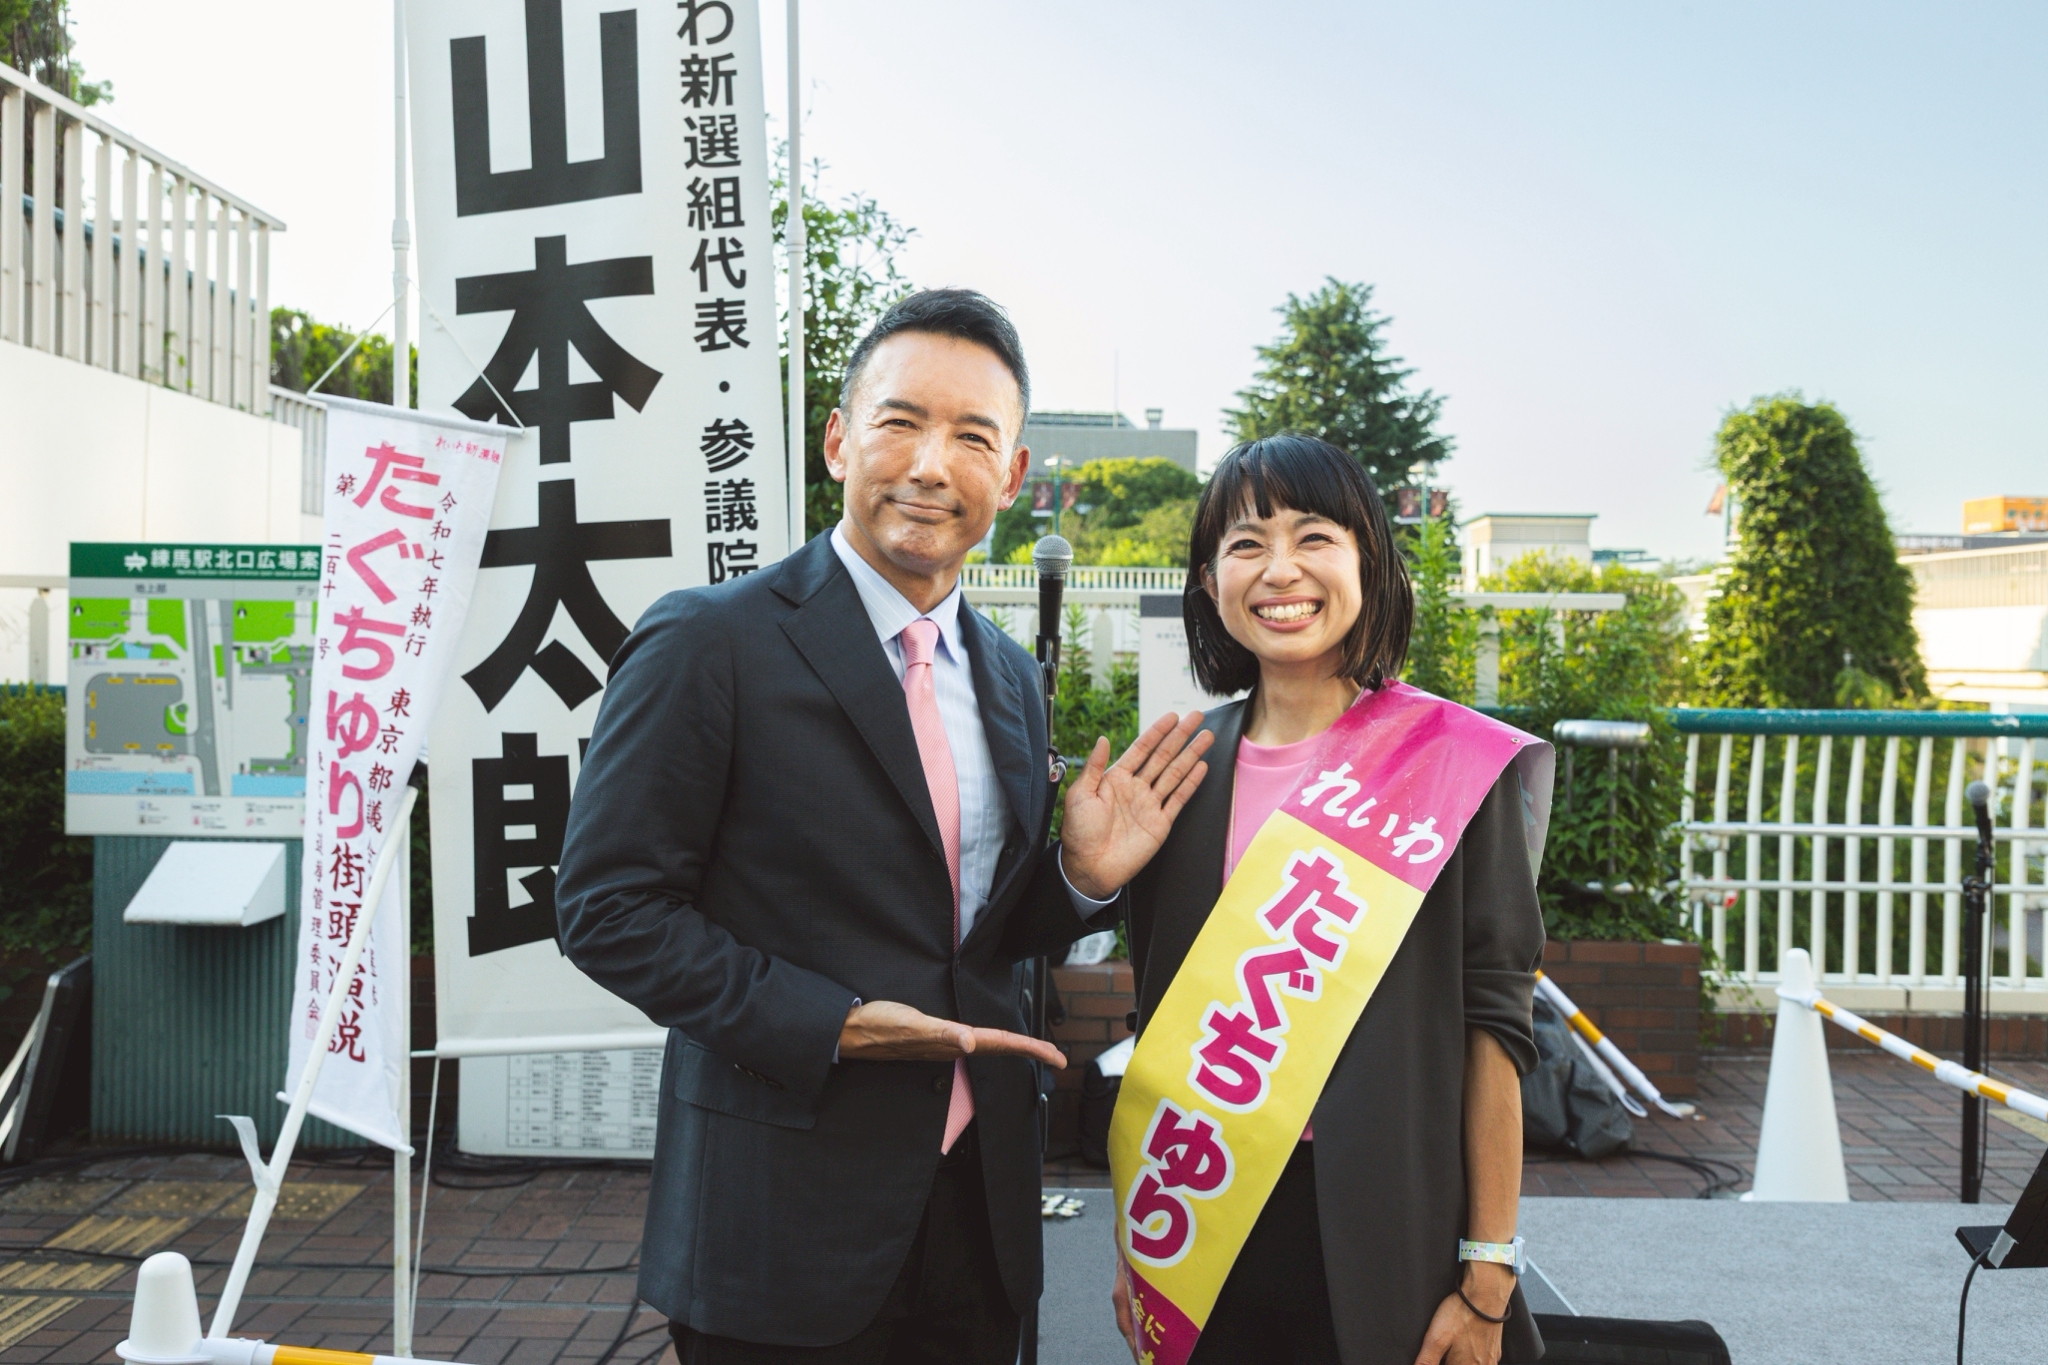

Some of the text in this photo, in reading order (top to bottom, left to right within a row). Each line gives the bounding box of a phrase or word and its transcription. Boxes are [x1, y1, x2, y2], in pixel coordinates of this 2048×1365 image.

[326, 441, 441, 839] たぐちゆり
[1302, 762, 1443, 864] れいわ
[1127, 853, 1359, 1260] たぐちゆり
